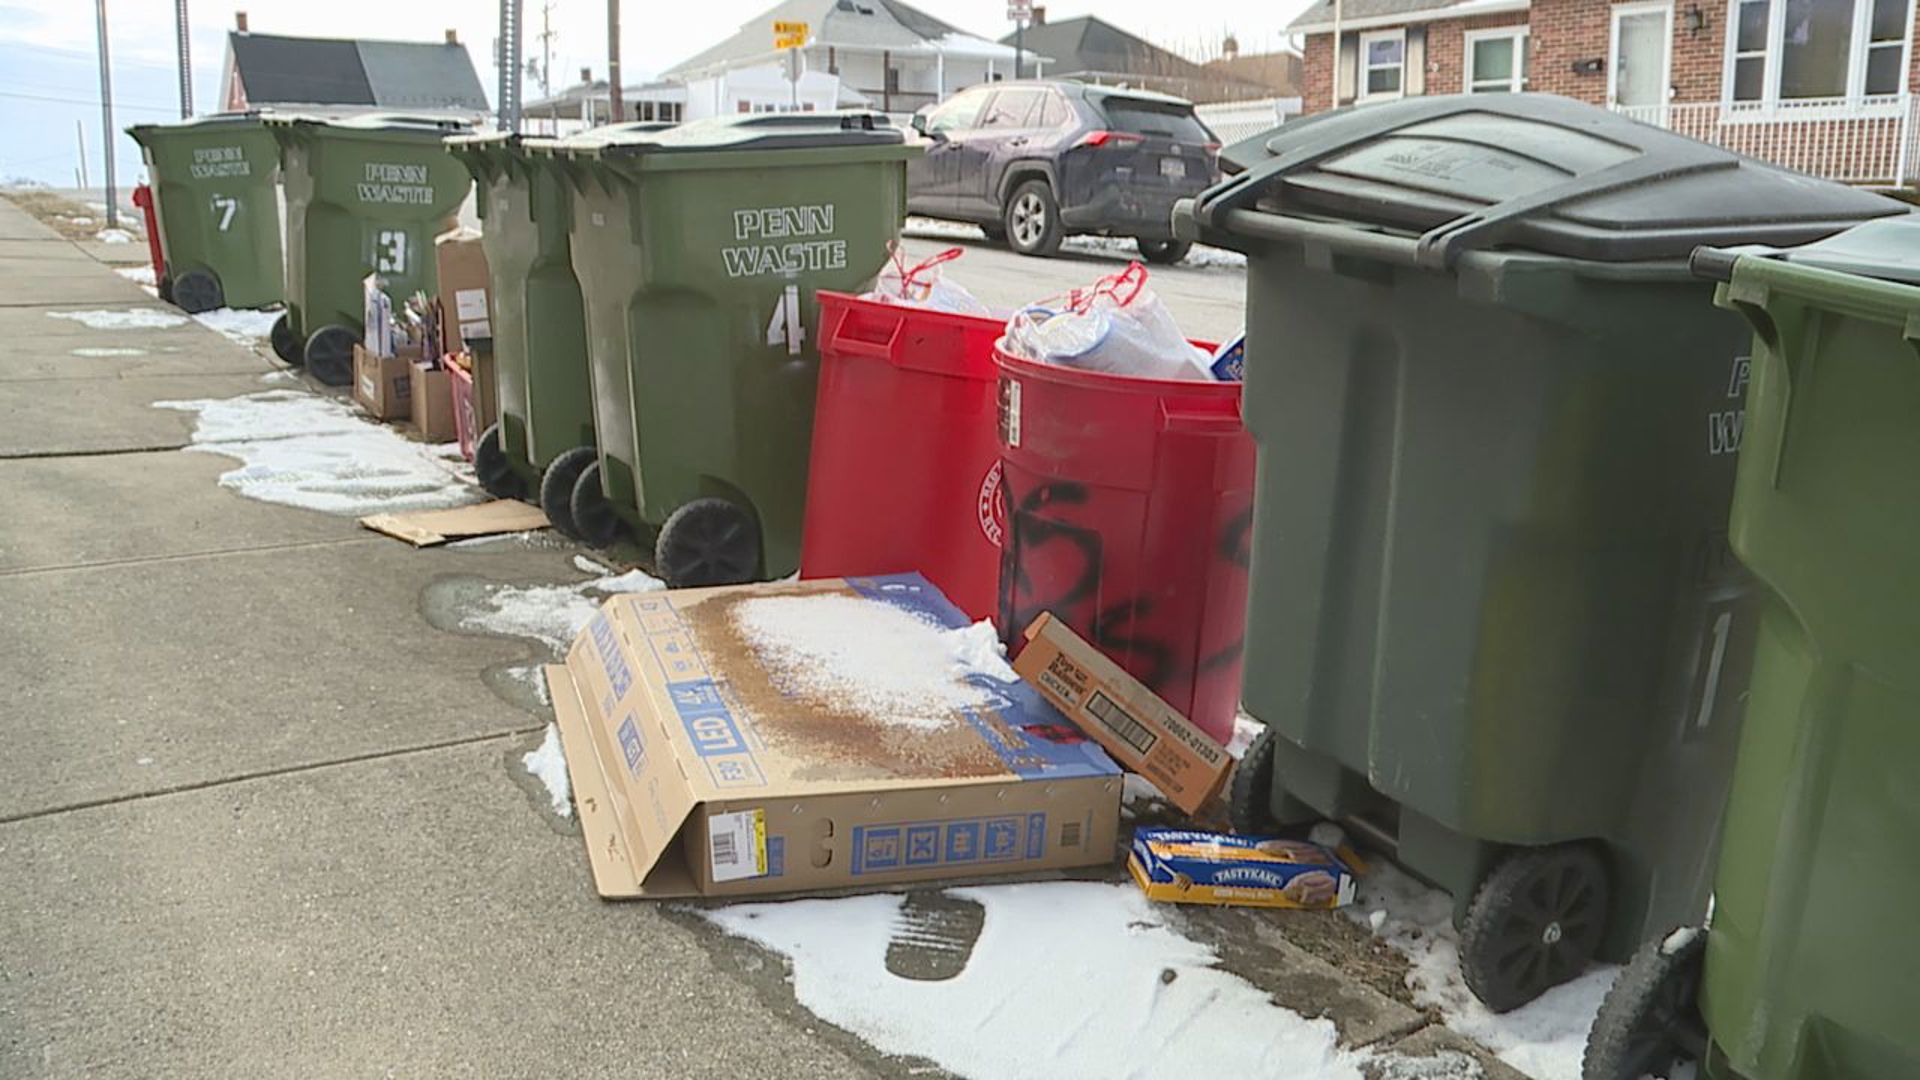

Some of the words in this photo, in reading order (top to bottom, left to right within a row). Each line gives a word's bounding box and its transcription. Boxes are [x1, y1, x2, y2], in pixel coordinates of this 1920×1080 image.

[191, 162, 250, 178] WASTE
[193, 146, 242, 163] PENN
[365, 163, 427, 185] PENN
[357, 183, 433, 204] WASTE
[215, 198, 236, 231] 7
[734, 203, 834, 241] PENN
[379, 231, 406, 273] 3
[722, 240, 847, 277] WASTE
[767, 285, 806, 355] 4
[692, 716, 740, 751] LED
[1215, 867, 1280, 887] TASTYKAKE
